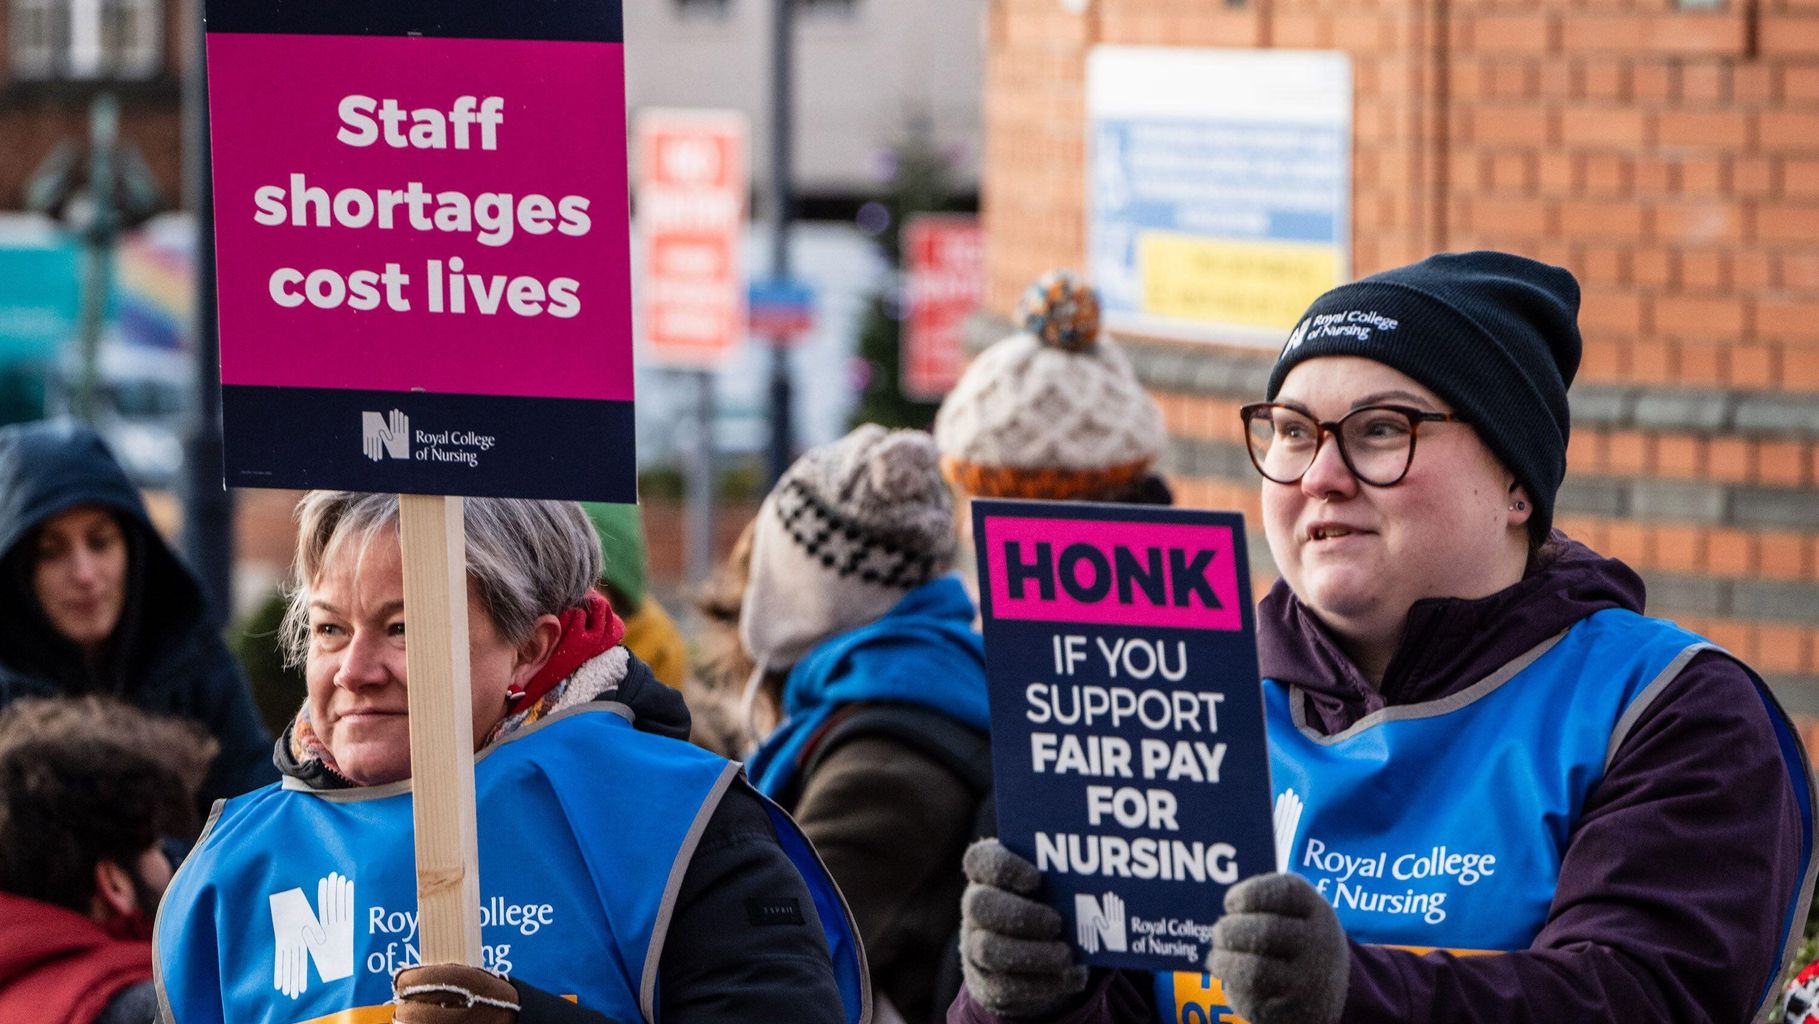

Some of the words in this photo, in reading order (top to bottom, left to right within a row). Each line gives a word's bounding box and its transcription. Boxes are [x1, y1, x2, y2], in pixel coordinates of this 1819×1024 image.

[336, 95, 504, 150] Staff
[254, 173, 592, 247] shortages
[269, 262, 411, 312] cost
[427, 256, 581, 318] lives
[1307, 326, 1321, 340] of
[1321, 323, 1371, 340] Nursing
[1312, 310, 1347, 328] Royal
[1347, 310, 1398, 330] College
[416, 430, 448, 448] Royal
[451, 431, 495, 451] College
[416, 447, 429, 460] of
[431, 448, 478, 467] Nursing
[1003, 541, 1223, 610] HONK
[1053, 635, 1087, 675] IF
[1096, 637, 1188, 682] YOU
[1026, 683, 1225, 733] SUPPORT
[1030, 732, 1133, 778] FAIR
[1141, 738, 1227, 783] PAY
[1087, 785, 1179, 831] FOR
[1035, 832, 1239, 885] NURSING
[1303, 838, 1387, 882] Royal
[1392, 846, 1496, 886] College
[369, 906, 419, 943] Roy
[480, 896, 554, 936] llege
[1131, 916, 1167, 937] Royal
[1333, 882, 1447, 924] Nursing
[367, 942, 398, 976] of
[1132, 937, 1146, 953] of
[1149, 939, 1199, 962] Nursing
